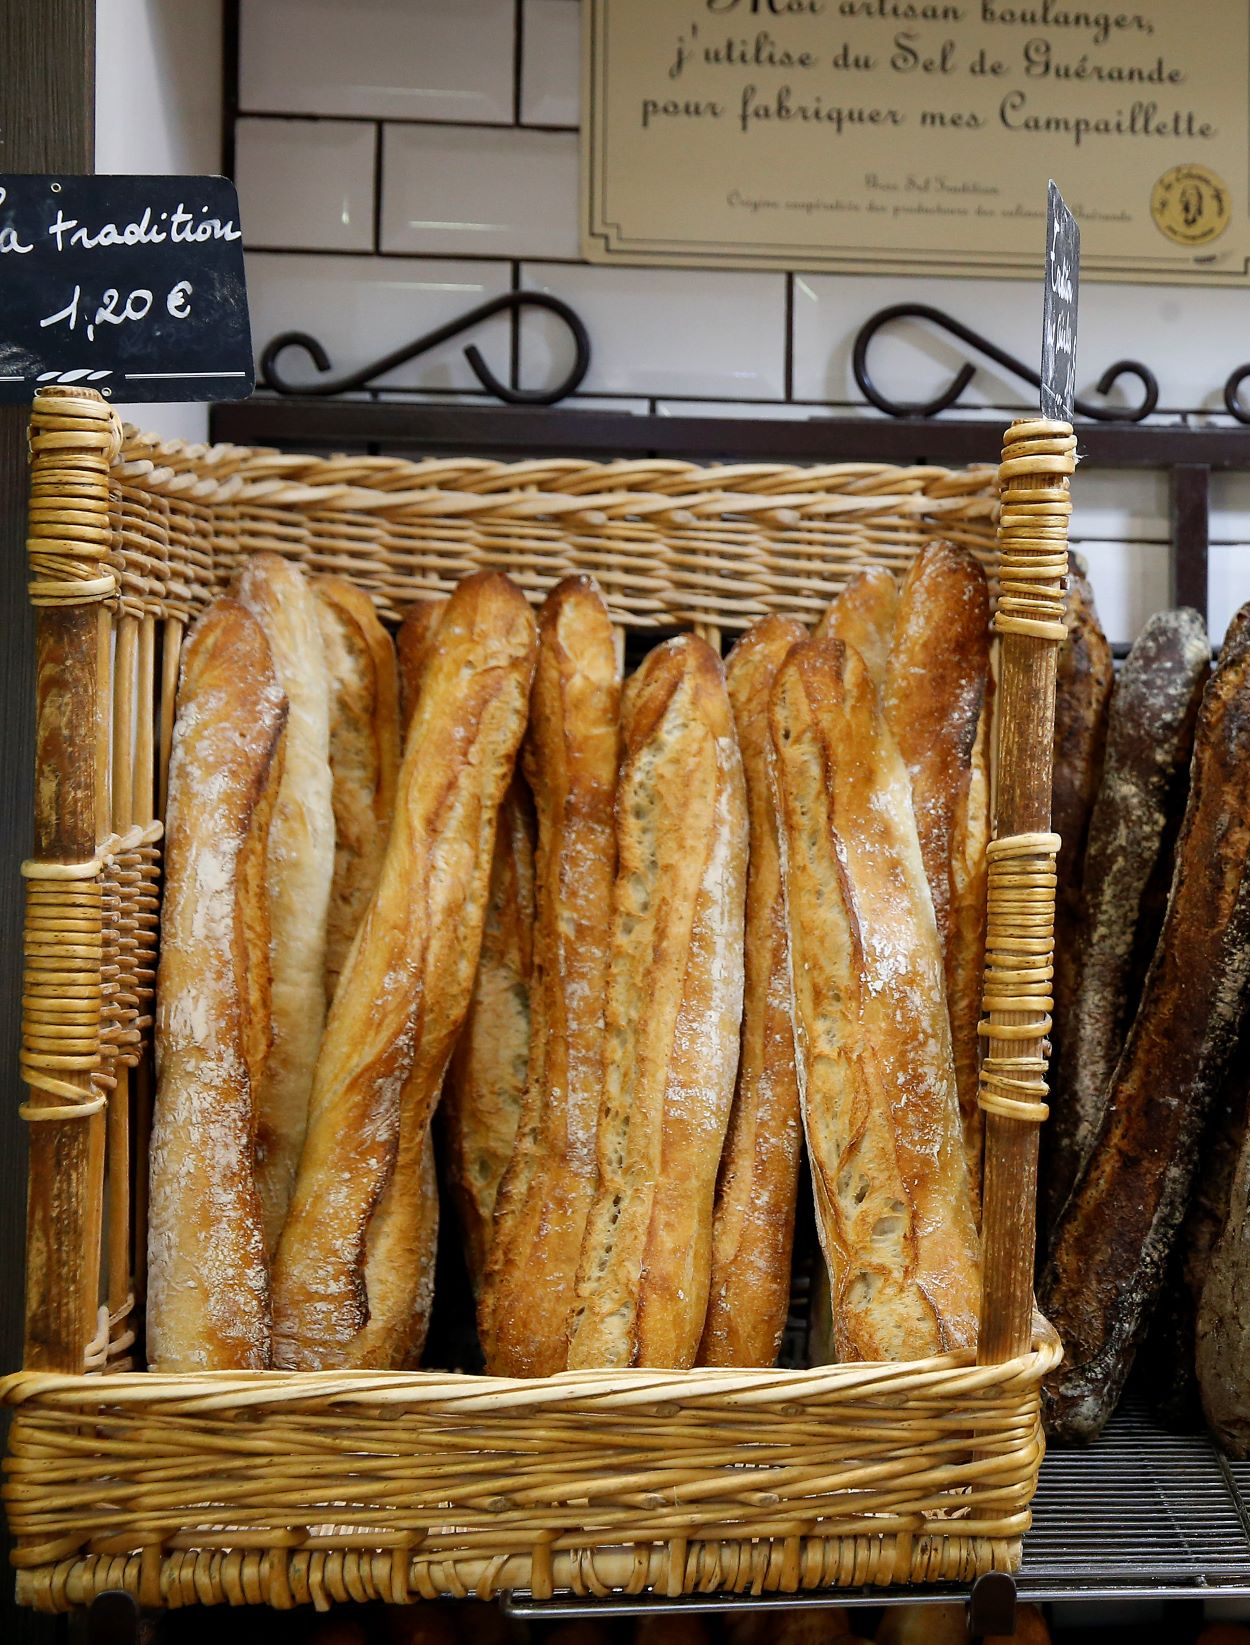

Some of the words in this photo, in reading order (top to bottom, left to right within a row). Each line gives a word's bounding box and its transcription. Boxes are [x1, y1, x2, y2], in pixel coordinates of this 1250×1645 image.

[668, 21, 818, 80] j'utilise
[832, 42, 876, 71] du
[890, 31, 956, 73] Sel
[969, 49, 1009, 77] de
[1023, 38, 1187, 84] Guérande
[838, 0, 963, 20] artisan
[981, 0, 1154, 45] boulanger,
[642, 98, 725, 128] pour
[739, 84, 903, 133] fabriquer
[920, 110, 986, 129] mes
[1000, 90, 1217, 147] Campaillette
[0, 187, 34, 254] a
[49, 203, 242, 251] tradition
[40, 285, 152, 341] 1,20
[167, 280, 193, 318] €
